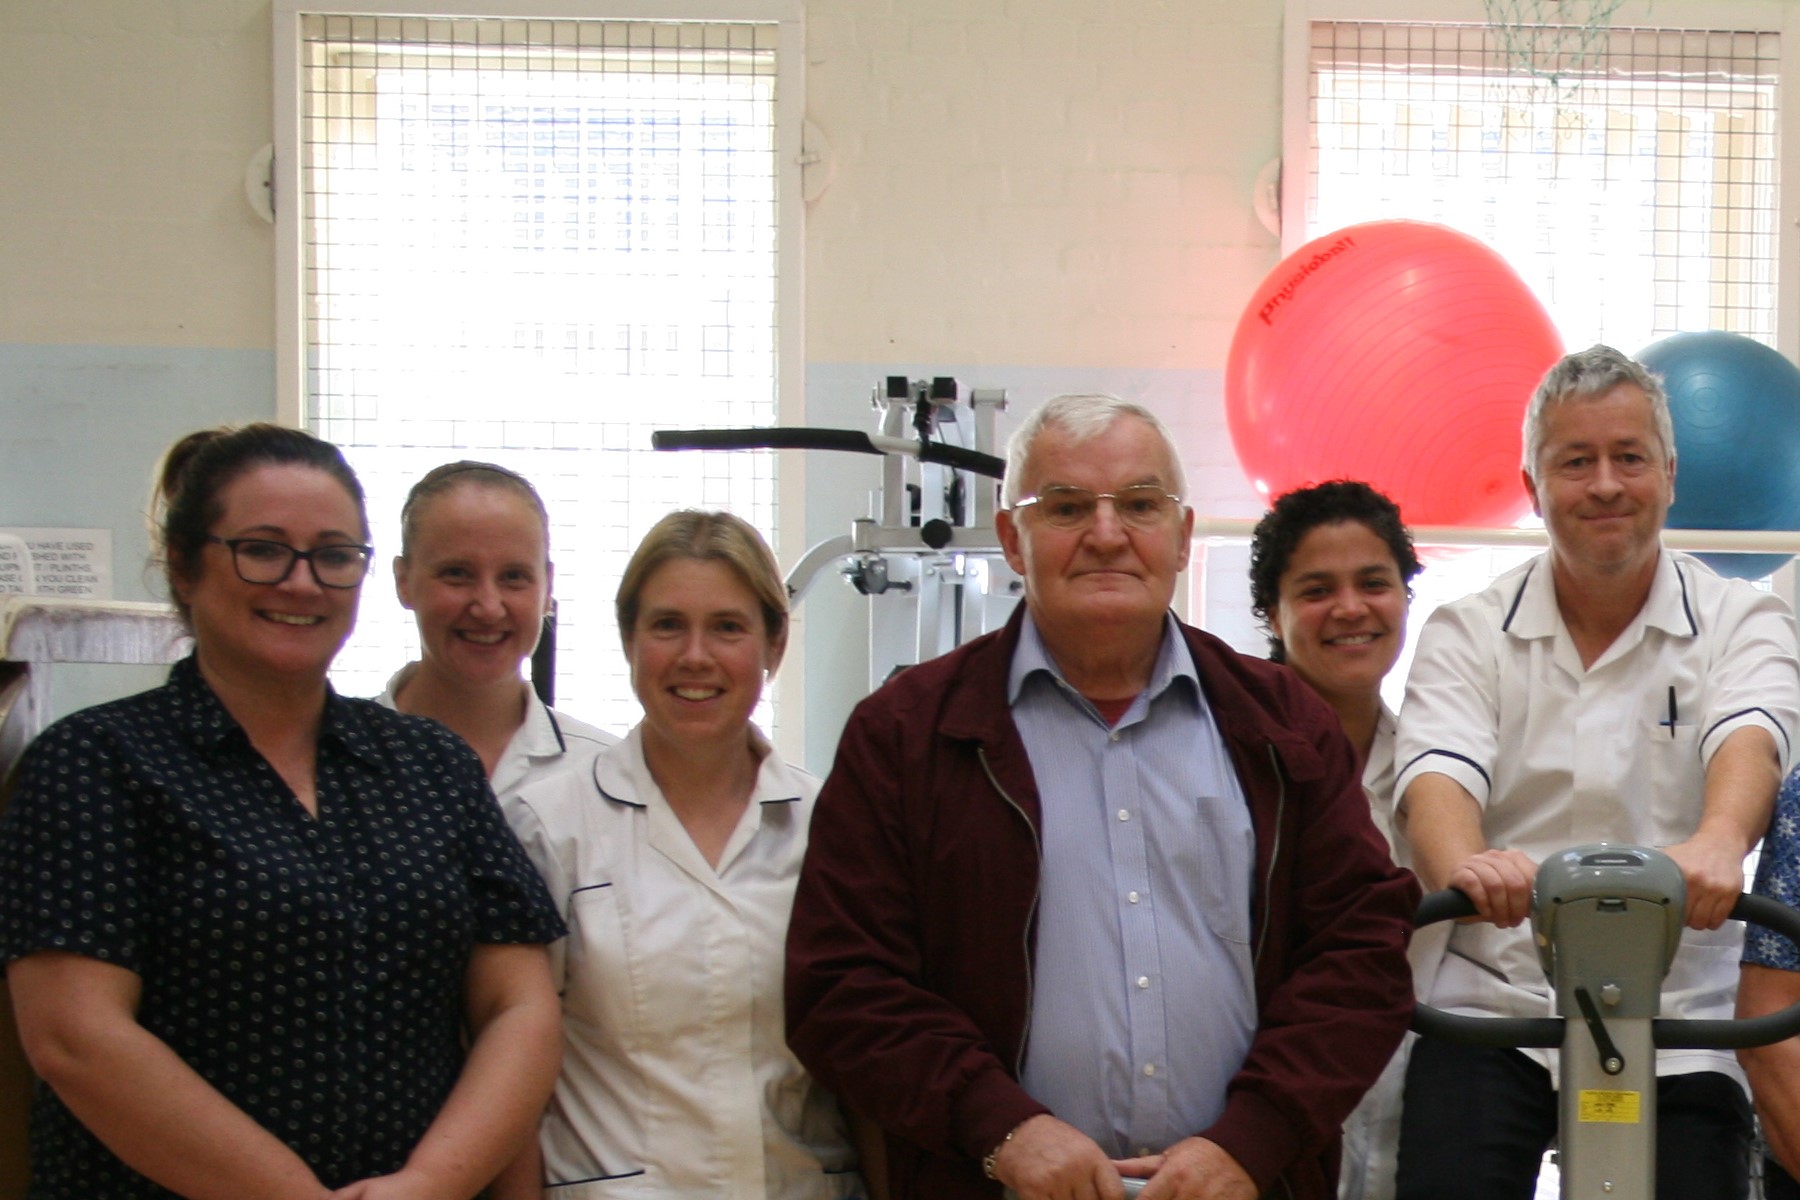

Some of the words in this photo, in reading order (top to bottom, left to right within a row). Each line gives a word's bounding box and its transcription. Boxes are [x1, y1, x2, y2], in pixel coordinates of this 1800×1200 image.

[1258, 236, 1356, 326] physioball
[37, 542, 64, 550] HAVE
[66, 542, 94, 550] USED
[64, 575, 98, 583] CLEAN
[57, 585, 93, 593] GREEN
